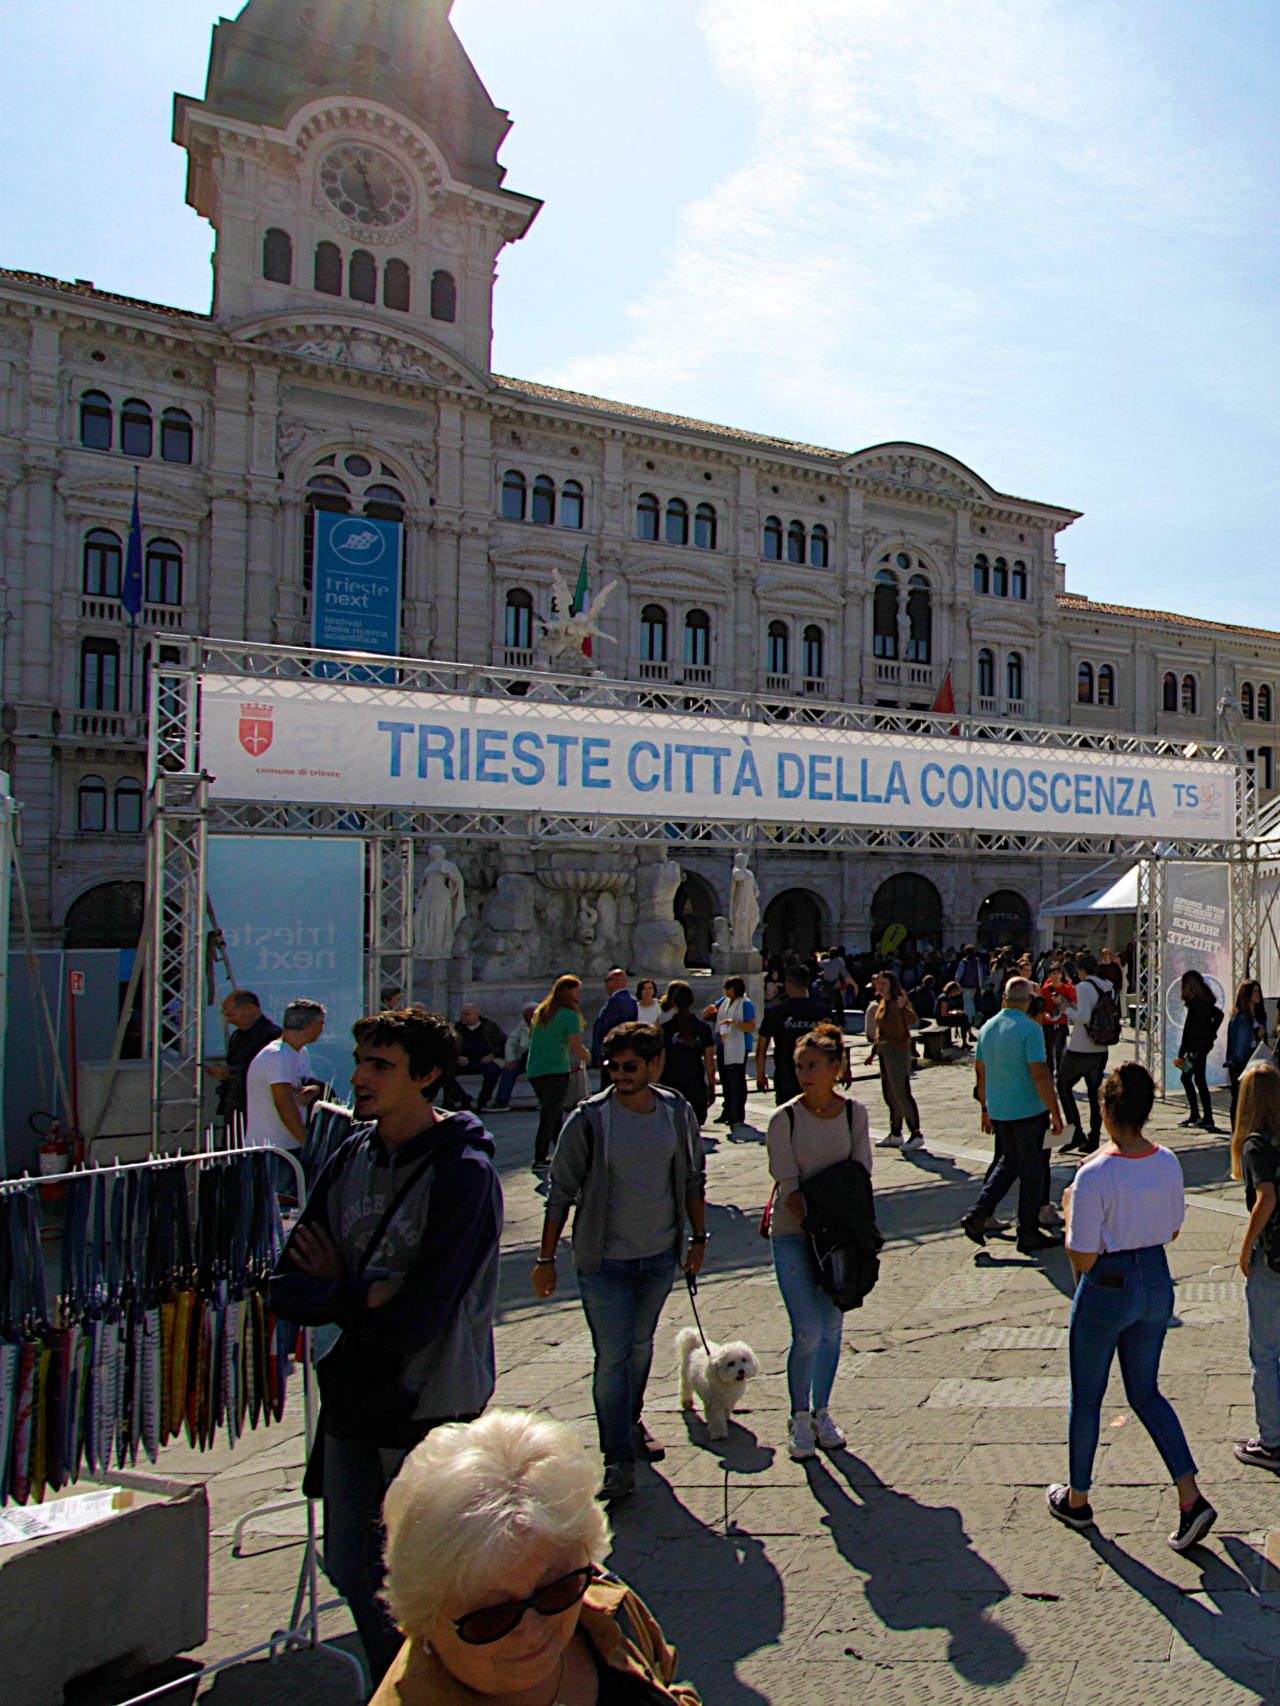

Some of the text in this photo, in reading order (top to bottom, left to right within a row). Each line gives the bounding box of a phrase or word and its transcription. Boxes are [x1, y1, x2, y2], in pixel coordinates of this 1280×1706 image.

[325, 576, 390, 597] trieste
[325, 592, 369, 608] next
[324, 616, 362, 628] festival
[324, 624, 388, 638] della ricerca
[324, 632, 377, 644] scientifica
[255, 767, 341, 778] comune di trieste
[377, 720, 1157, 818] TRIESTE CITTÀ DELLA CONOSCENZA
[1172, 782, 1199, 809] TS
